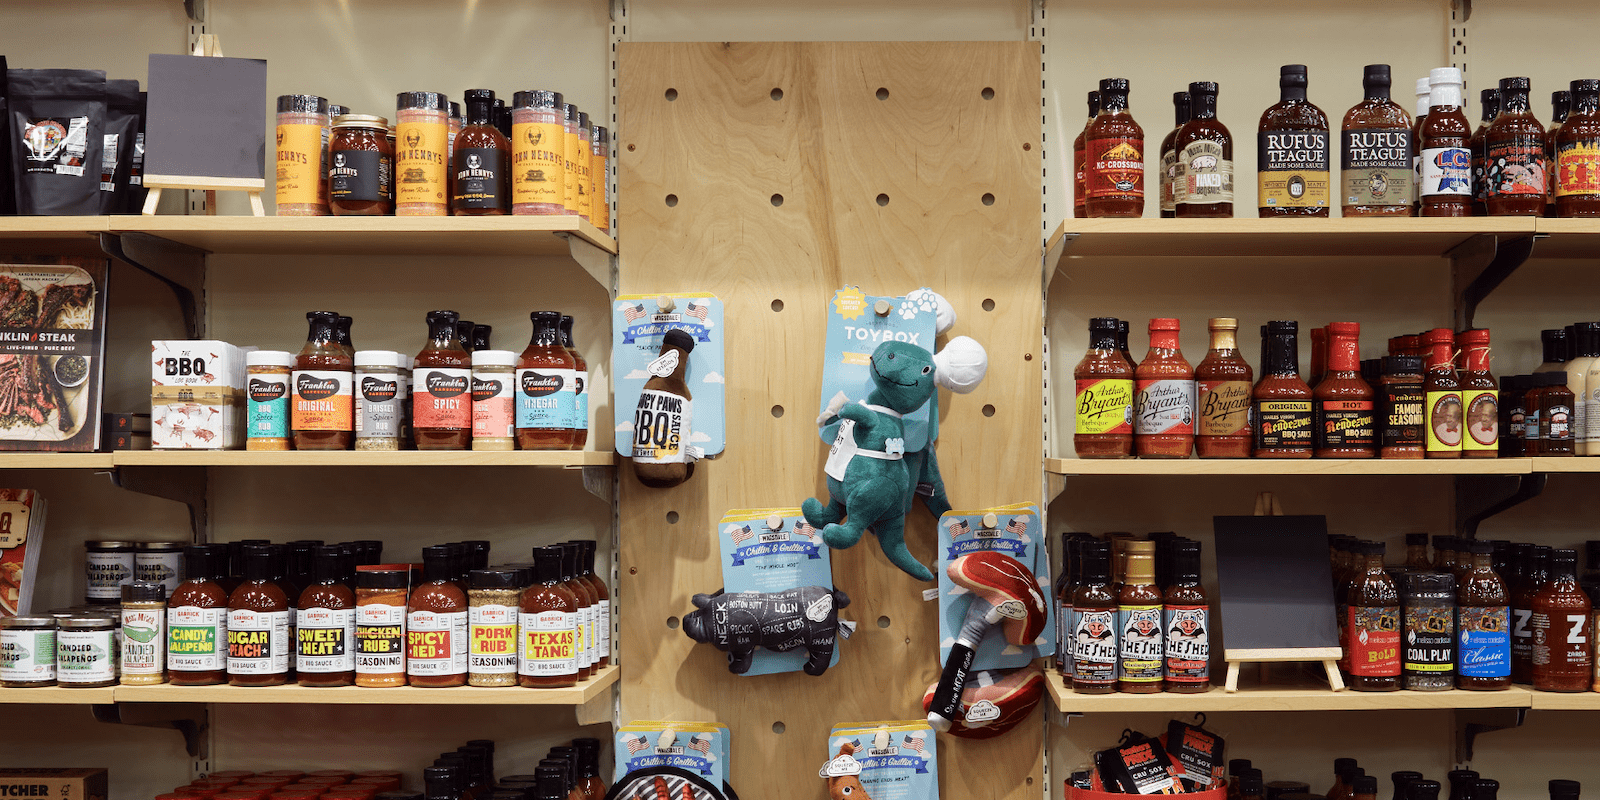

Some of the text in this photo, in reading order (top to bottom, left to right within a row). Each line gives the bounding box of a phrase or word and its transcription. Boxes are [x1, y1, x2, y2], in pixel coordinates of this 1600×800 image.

[1267, 134, 1325, 149] RUFUS
[1350, 133, 1407, 148] RUFUS
[1267, 150, 1325, 162] TEAGUE
[1350, 149, 1407, 161] TEAGUE
[1196, 173, 1221, 187] NAKED
[39, 333, 76, 343] STEAK
[844, 326, 920, 345] TOYBOX
[165, 357, 206, 376] BBQ
[250, 383, 282, 394] Franklin
[299, 380, 336, 391] Franklin
[364, 383, 396, 393] Franklin
[430, 377, 465, 388] Franklin
[524, 377, 559, 388] Franklin
[1095, 385, 1125, 397] Arthur
[1150, 384, 1180, 397] Arthur
[298, 401, 336, 412] ORIGINAL
[368, 404, 394, 413] BRISKET
[433, 399, 460, 410] SPICY
[523, 398, 558, 409] VINEGAR
[656, 395, 683, 414] PAWS
[1394, 403, 1423, 415] FAMOUS
[258, 422, 271, 431] RUB
[668, 414, 682, 451] SAUCE
[1281, 430, 1297, 439] BBQ
[1344, 429, 1360, 437] BBQ
[749, 601, 763, 609] BUTT
[774, 602, 798, 614] LOIN
[716, 602, 728, 645] NECK
[730, 624, 754, 635] PICNIC
[762, 618, 805, 636] SPARE RIBS
[1567, 614, 1587, 644] Z
[171, 628, 209, 641] CANDY
[228, 631, 268, 644] SUGAR
[299, 629, 342, 642] SWEET
[408, 632, 445, 645] SPICY
[475, 627, 513, 639] PORK
[528, 632, 573, 645] TEXAS
[59, 643, 92, 652] CANDIED
[302, 642, 336, 655] HEAT
[363, 640, 390, 652] RUB
[480, 640, 507, 652] RUB
[778, 637, 806, 651] BACON
[229, 644, 262, 657] PEACH
[413, 645, 436, 658] RED
[533, 645, 569, 658] TANG
[1368, 647, 1396, 662] BOLD
[1407, 649, 1451, 661] COAL PLAY
[1463, 645, 1504, 664] Classic
[356, 656, 401, 667] SEASONING
[471, 656, 517, 667] SEASONING
[1132, 765, 1164, 780] CRU SOX
[0, 784, 49, 797] TCHER
